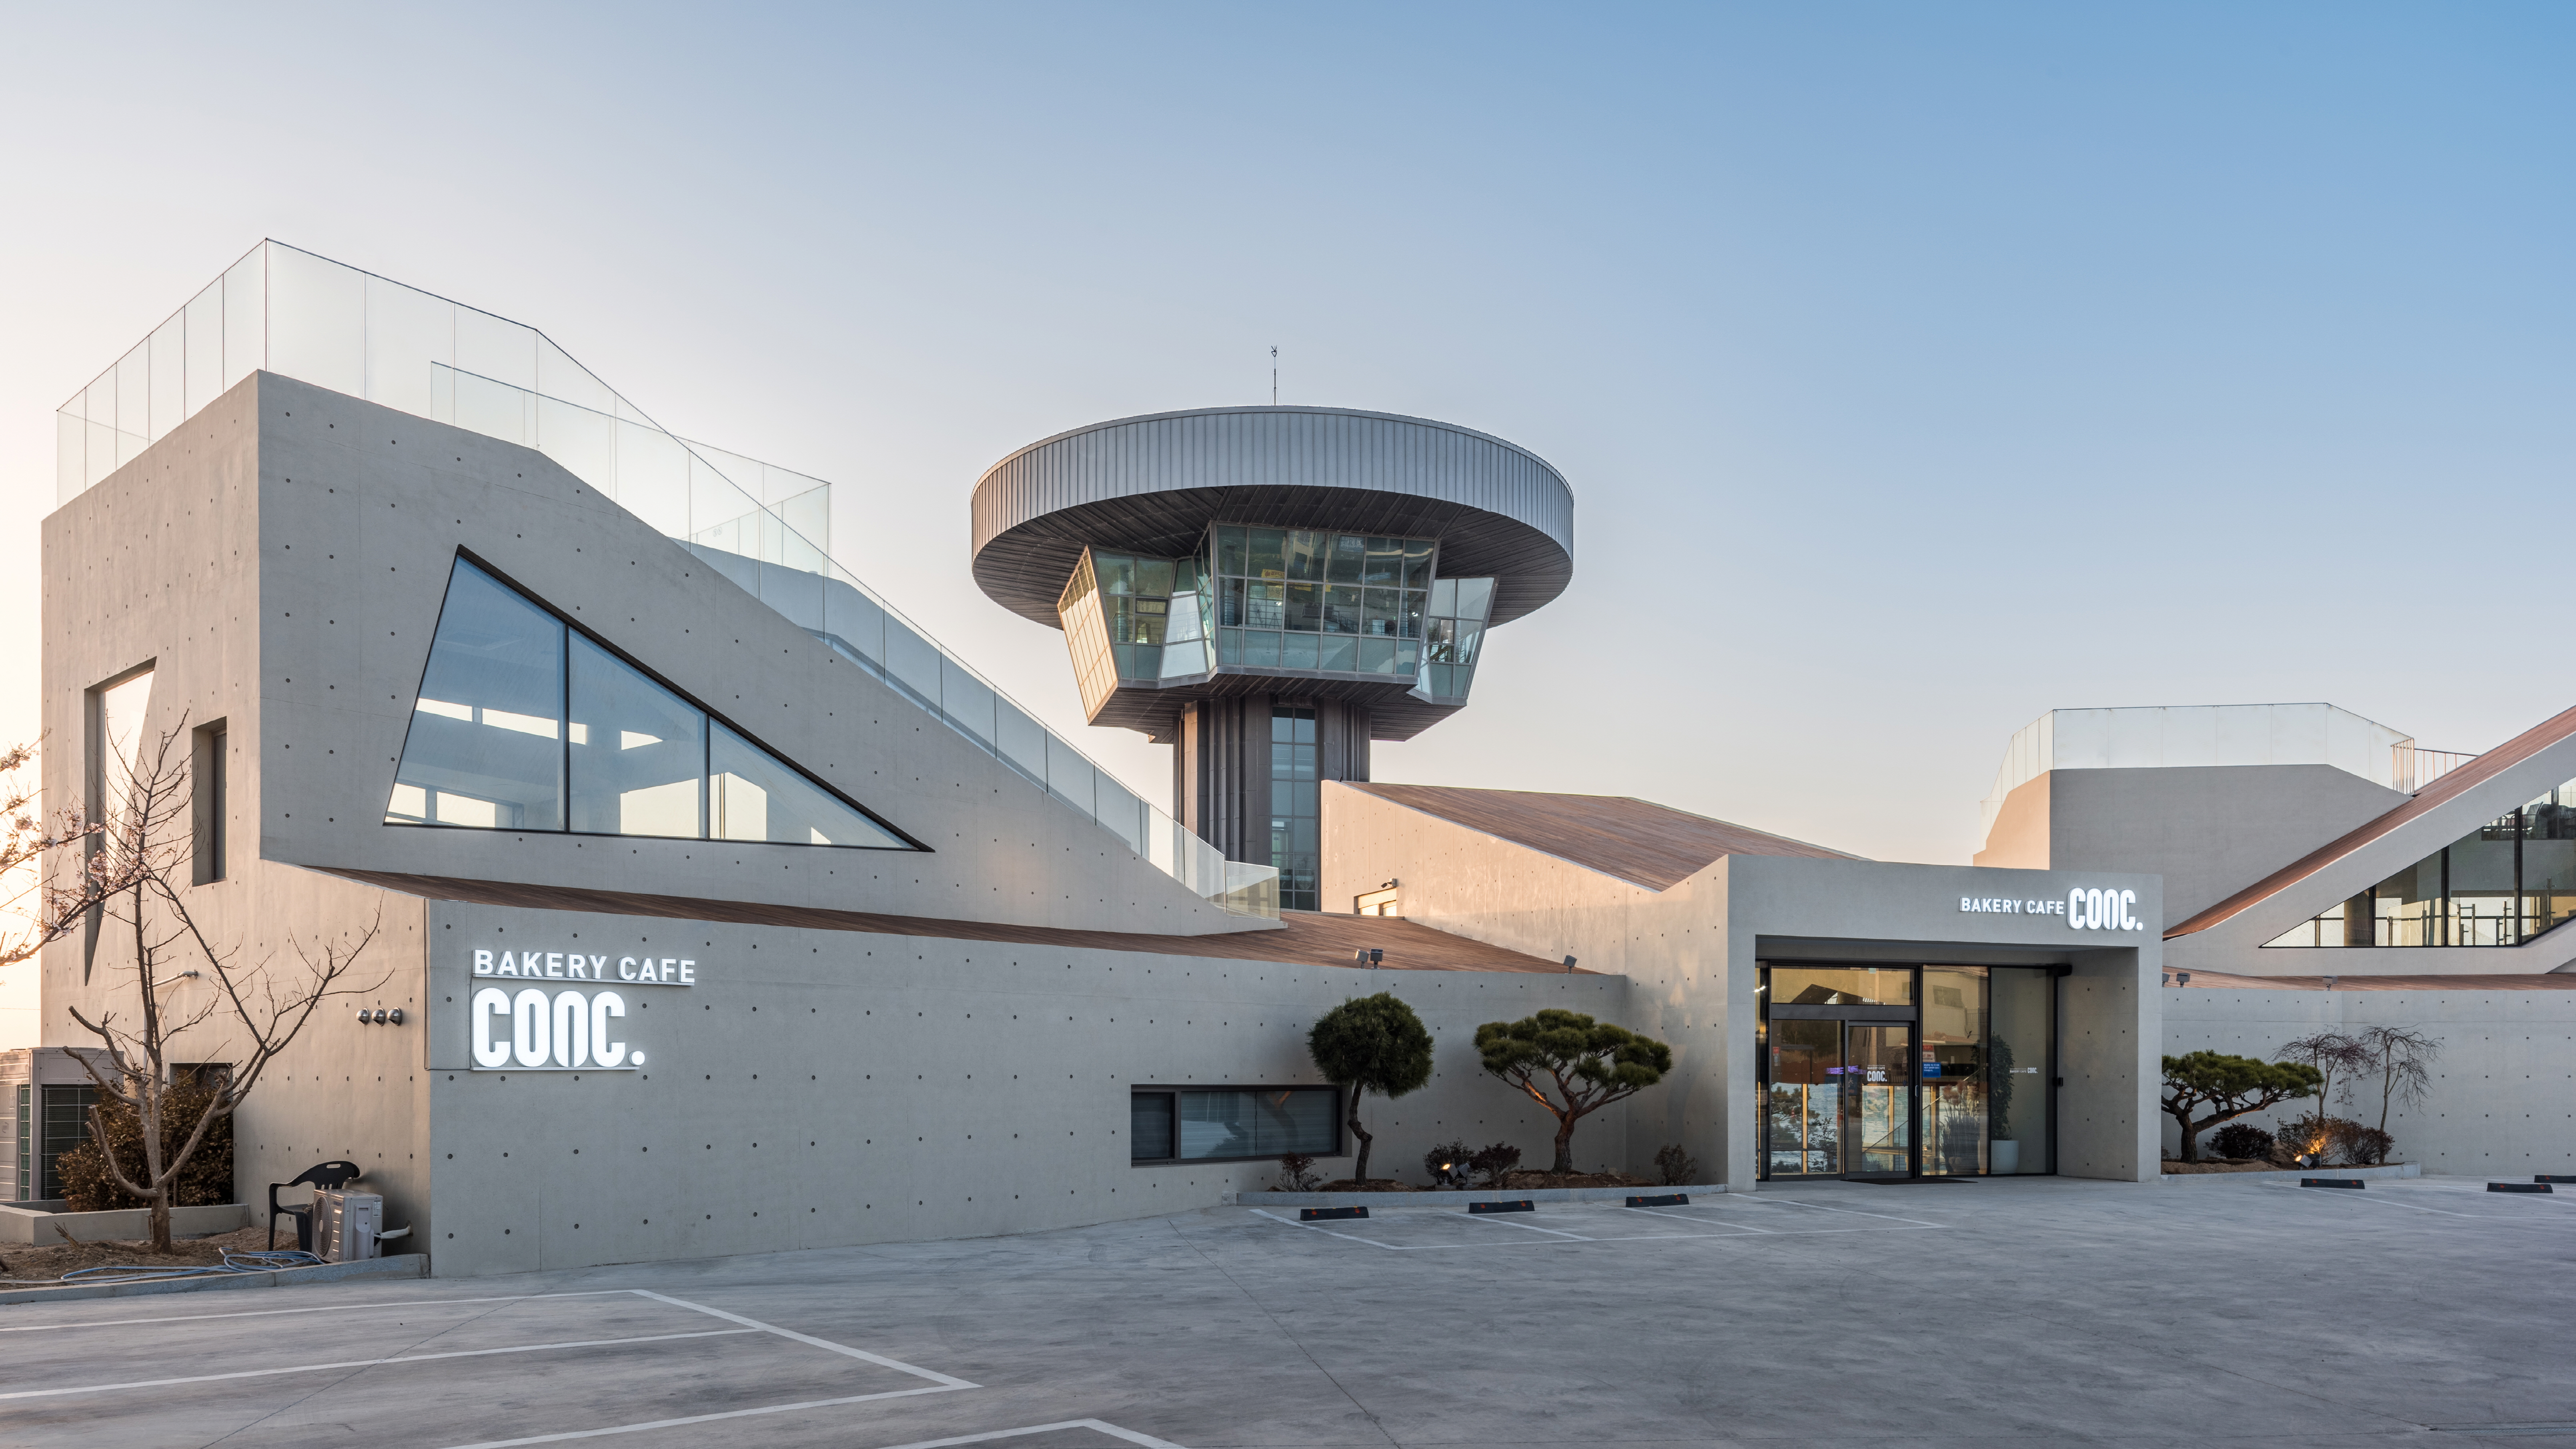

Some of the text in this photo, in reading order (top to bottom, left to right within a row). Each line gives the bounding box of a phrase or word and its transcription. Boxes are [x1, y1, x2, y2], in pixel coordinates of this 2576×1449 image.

[1959, 897, 2022, 913] BAKERY
[2025, 900, 2064, 915] CAFE
[473, 949, 695, 983] BAKERY CAFE
